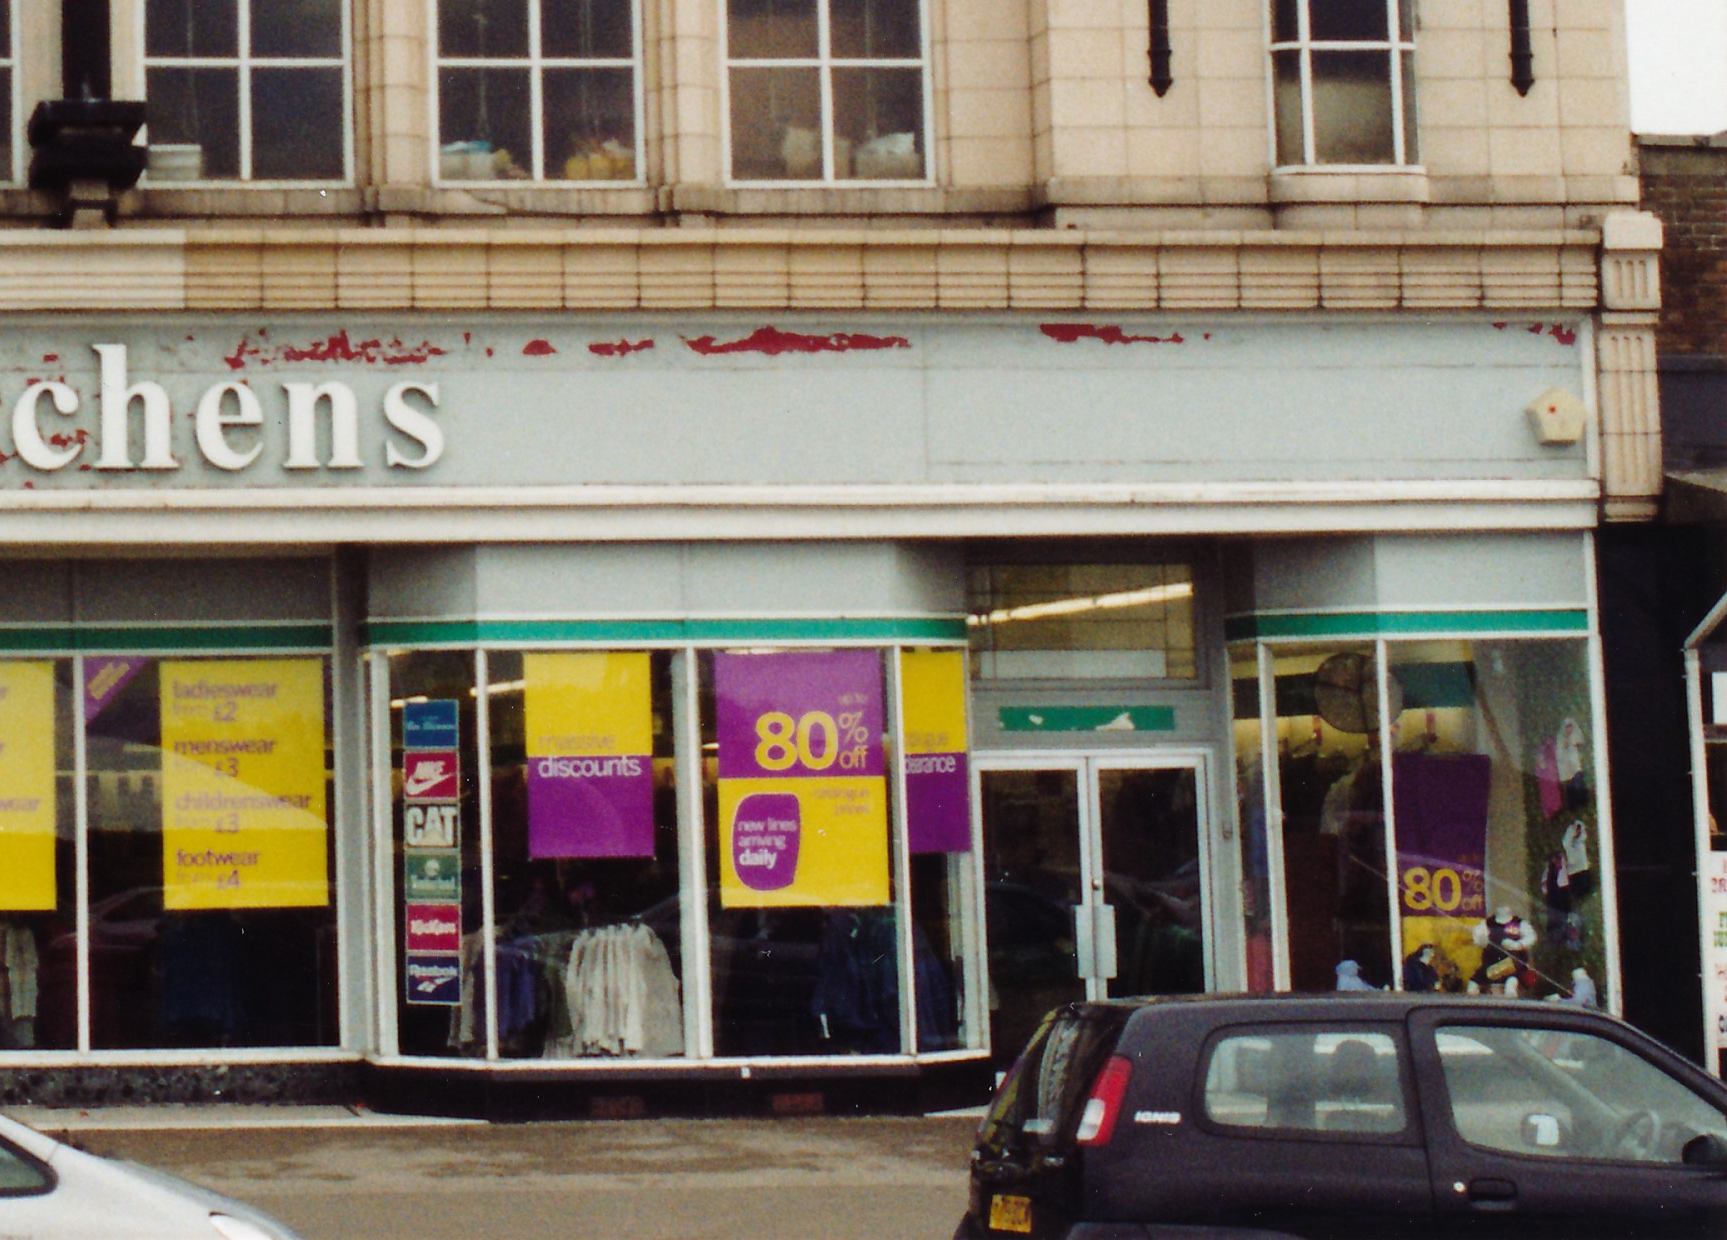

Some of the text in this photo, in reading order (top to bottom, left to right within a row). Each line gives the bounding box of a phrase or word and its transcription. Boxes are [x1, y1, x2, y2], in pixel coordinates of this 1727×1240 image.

[173, 680, 278, 699] ladieswear
[173, 739, 277, 756] menswear
[839, 745, 868, 770] off
[537, 754, 642, 778] discounts
[175, 791, 311, 812] childrenswear
[406, 806, 457, 846] CAT
[738, 817, 797, 832] new lines
[738, 834, 787, 850] arriving
[177, 848, 259, 867] footwear
[739, 849, 778, 870] daily
